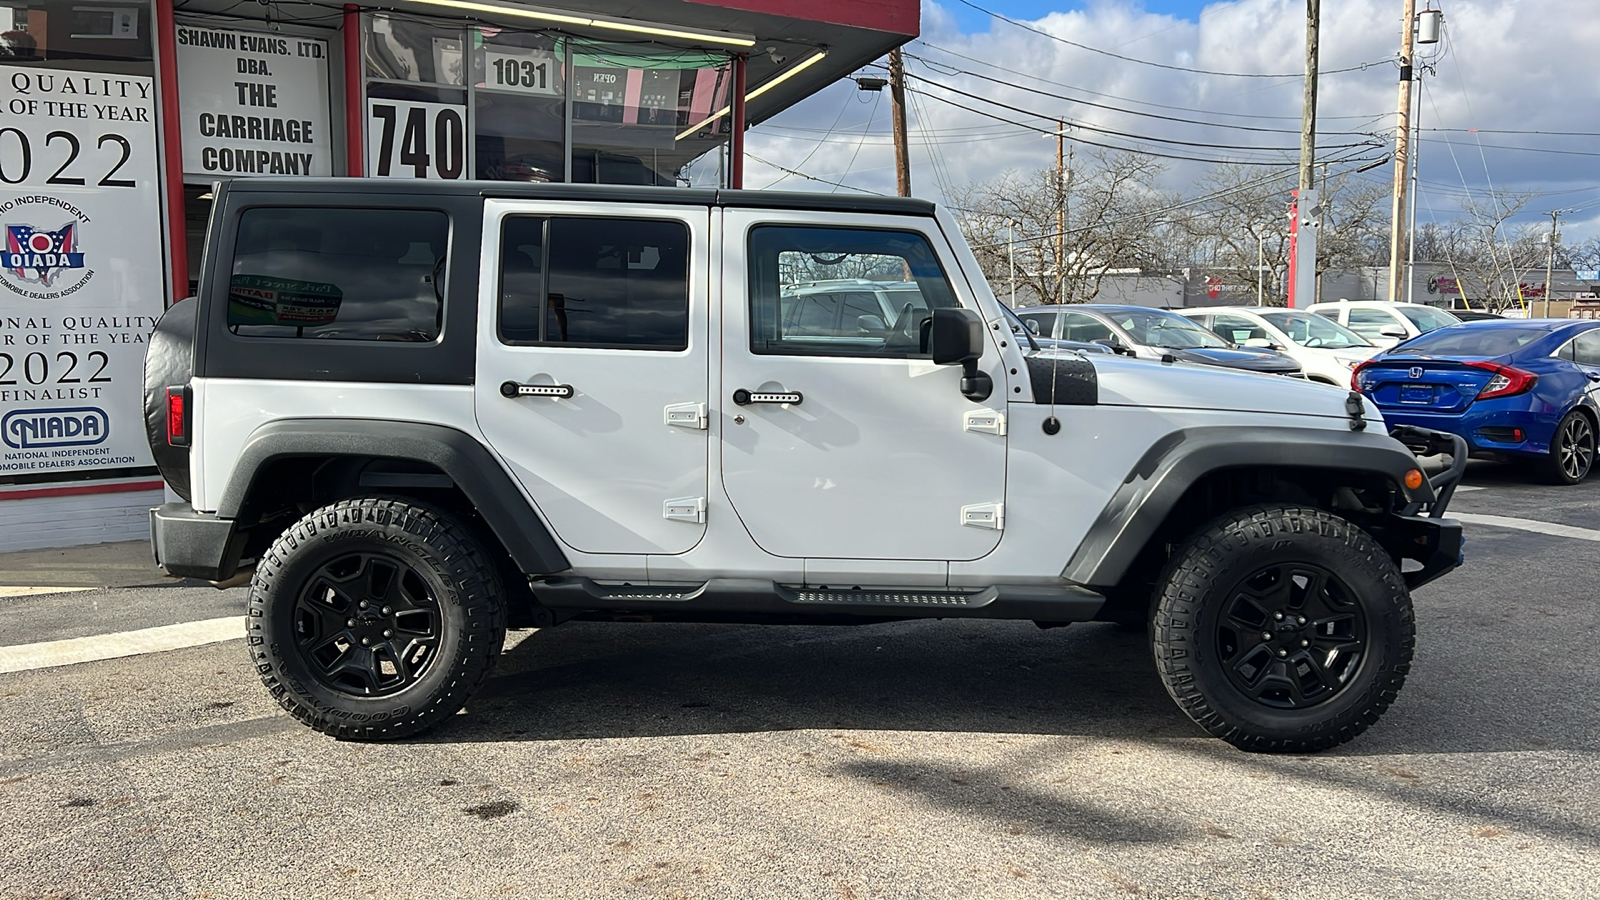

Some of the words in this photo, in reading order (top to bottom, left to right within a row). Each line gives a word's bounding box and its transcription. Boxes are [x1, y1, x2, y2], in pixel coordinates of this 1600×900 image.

[178, 28, 236, 50] SHAWN
[240, 35, 291, 56] EVANS.
[297, 41, 326, 59] LTD.
[237, 58, 273, 76] DBA.
[493, 58, 547, 89] 1031
[11, 72, 151, 99] QUALITY
[234, 81, 278, 108] THE
[9, 99, 38, 115] OF
[44, 101, 88, 118] THE
[93, 104, 149, 122] YEAR
[200, 112, 313, 144] CARRIAGE
[372, 104, 463, 180] 740
[202, 147, 313, 176] COMPANY
[14, 195, 91, 224] INDEPENDENT
[10, 254, 71, 267] OIADA
[29, 291, 60, 300] DEALERS
[61, 269, 95, 297] ASSOCIATION
[0, 317, 52, 329] NAL
[63, 316, 158, 330] QUALITY
[25, 334, 50, 346] OF
[60, 333, 99, 345] THE
[0, 351, 112, 385] 2022
[1, 388, 102, 401] FINALIST
[10, 415, 100, 441] NIADA
[0, 462, 36, 471] MOBILE
[38, 459, 76, 469] DEALERS
[77, 456, 135, 467] ASSOCIATION
[5, 451, 49, 460] NATIONAL
[52, 448, 111, 458] INDEPENDENT
[322, 528, 460, 606] WRANGLER
